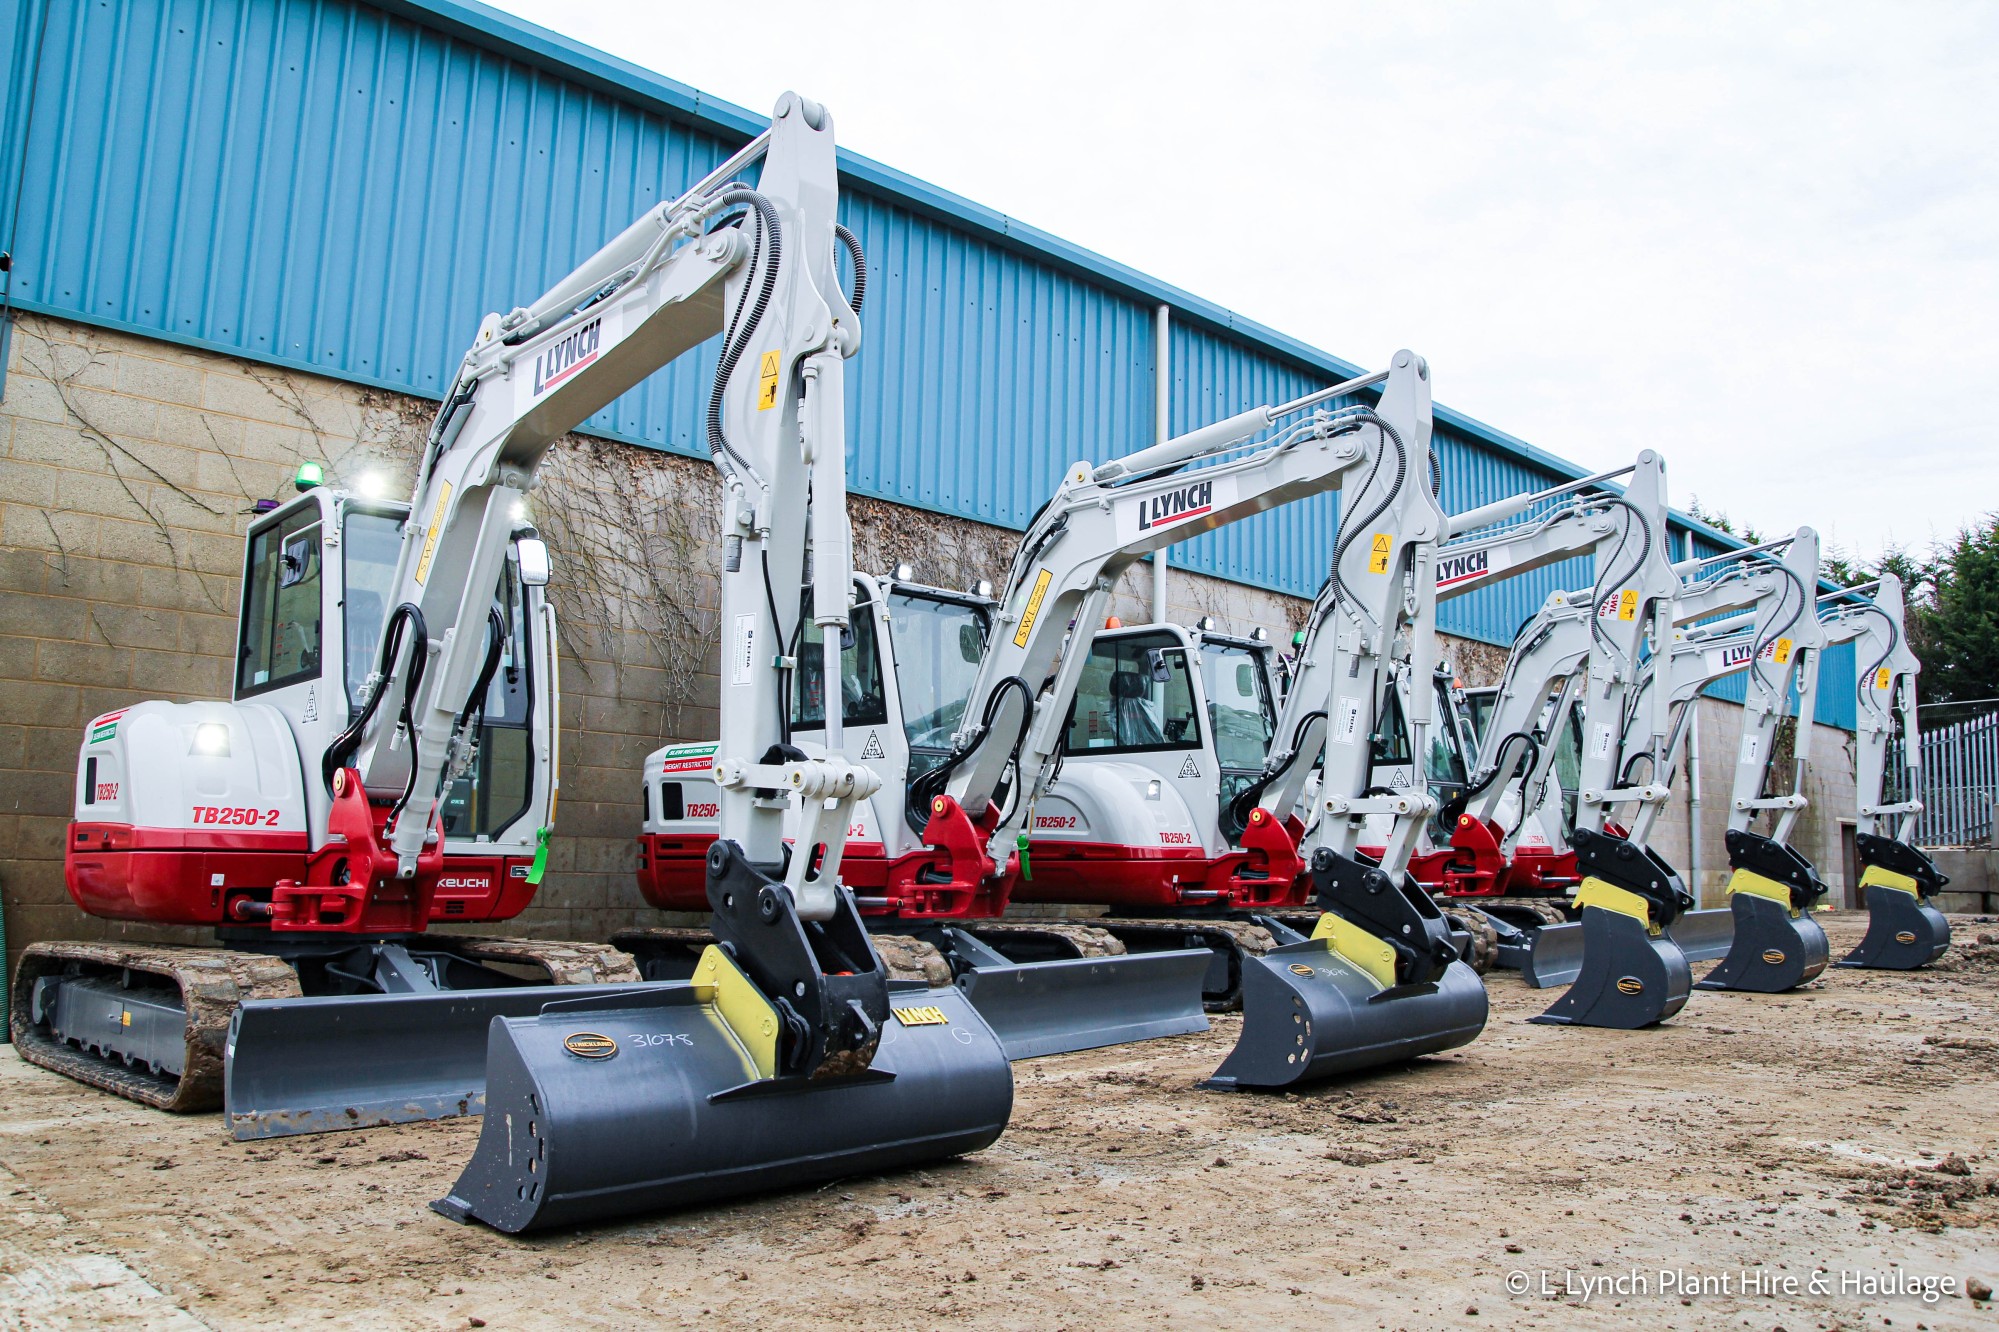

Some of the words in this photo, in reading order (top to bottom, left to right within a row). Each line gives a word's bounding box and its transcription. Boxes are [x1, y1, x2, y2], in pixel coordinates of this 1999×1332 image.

[1436, 550, 1488, 582] LYNCH
[1609, 593, 1619, 615] SWL
[664, 762, 682, 770] HEIGHT
[682, 760, 712, 769] RESTRICTOR
[192, 806, 280, 826] TB250-2
[687, 803, 720, 818] TB250-
[1035, 816, 1076, 828] TB250-2
[1159, 832, 1192, 844] TB250-2
[437, 878, 489, 888] KEUCHI
[628, 1033, 694, 1048] 31078
